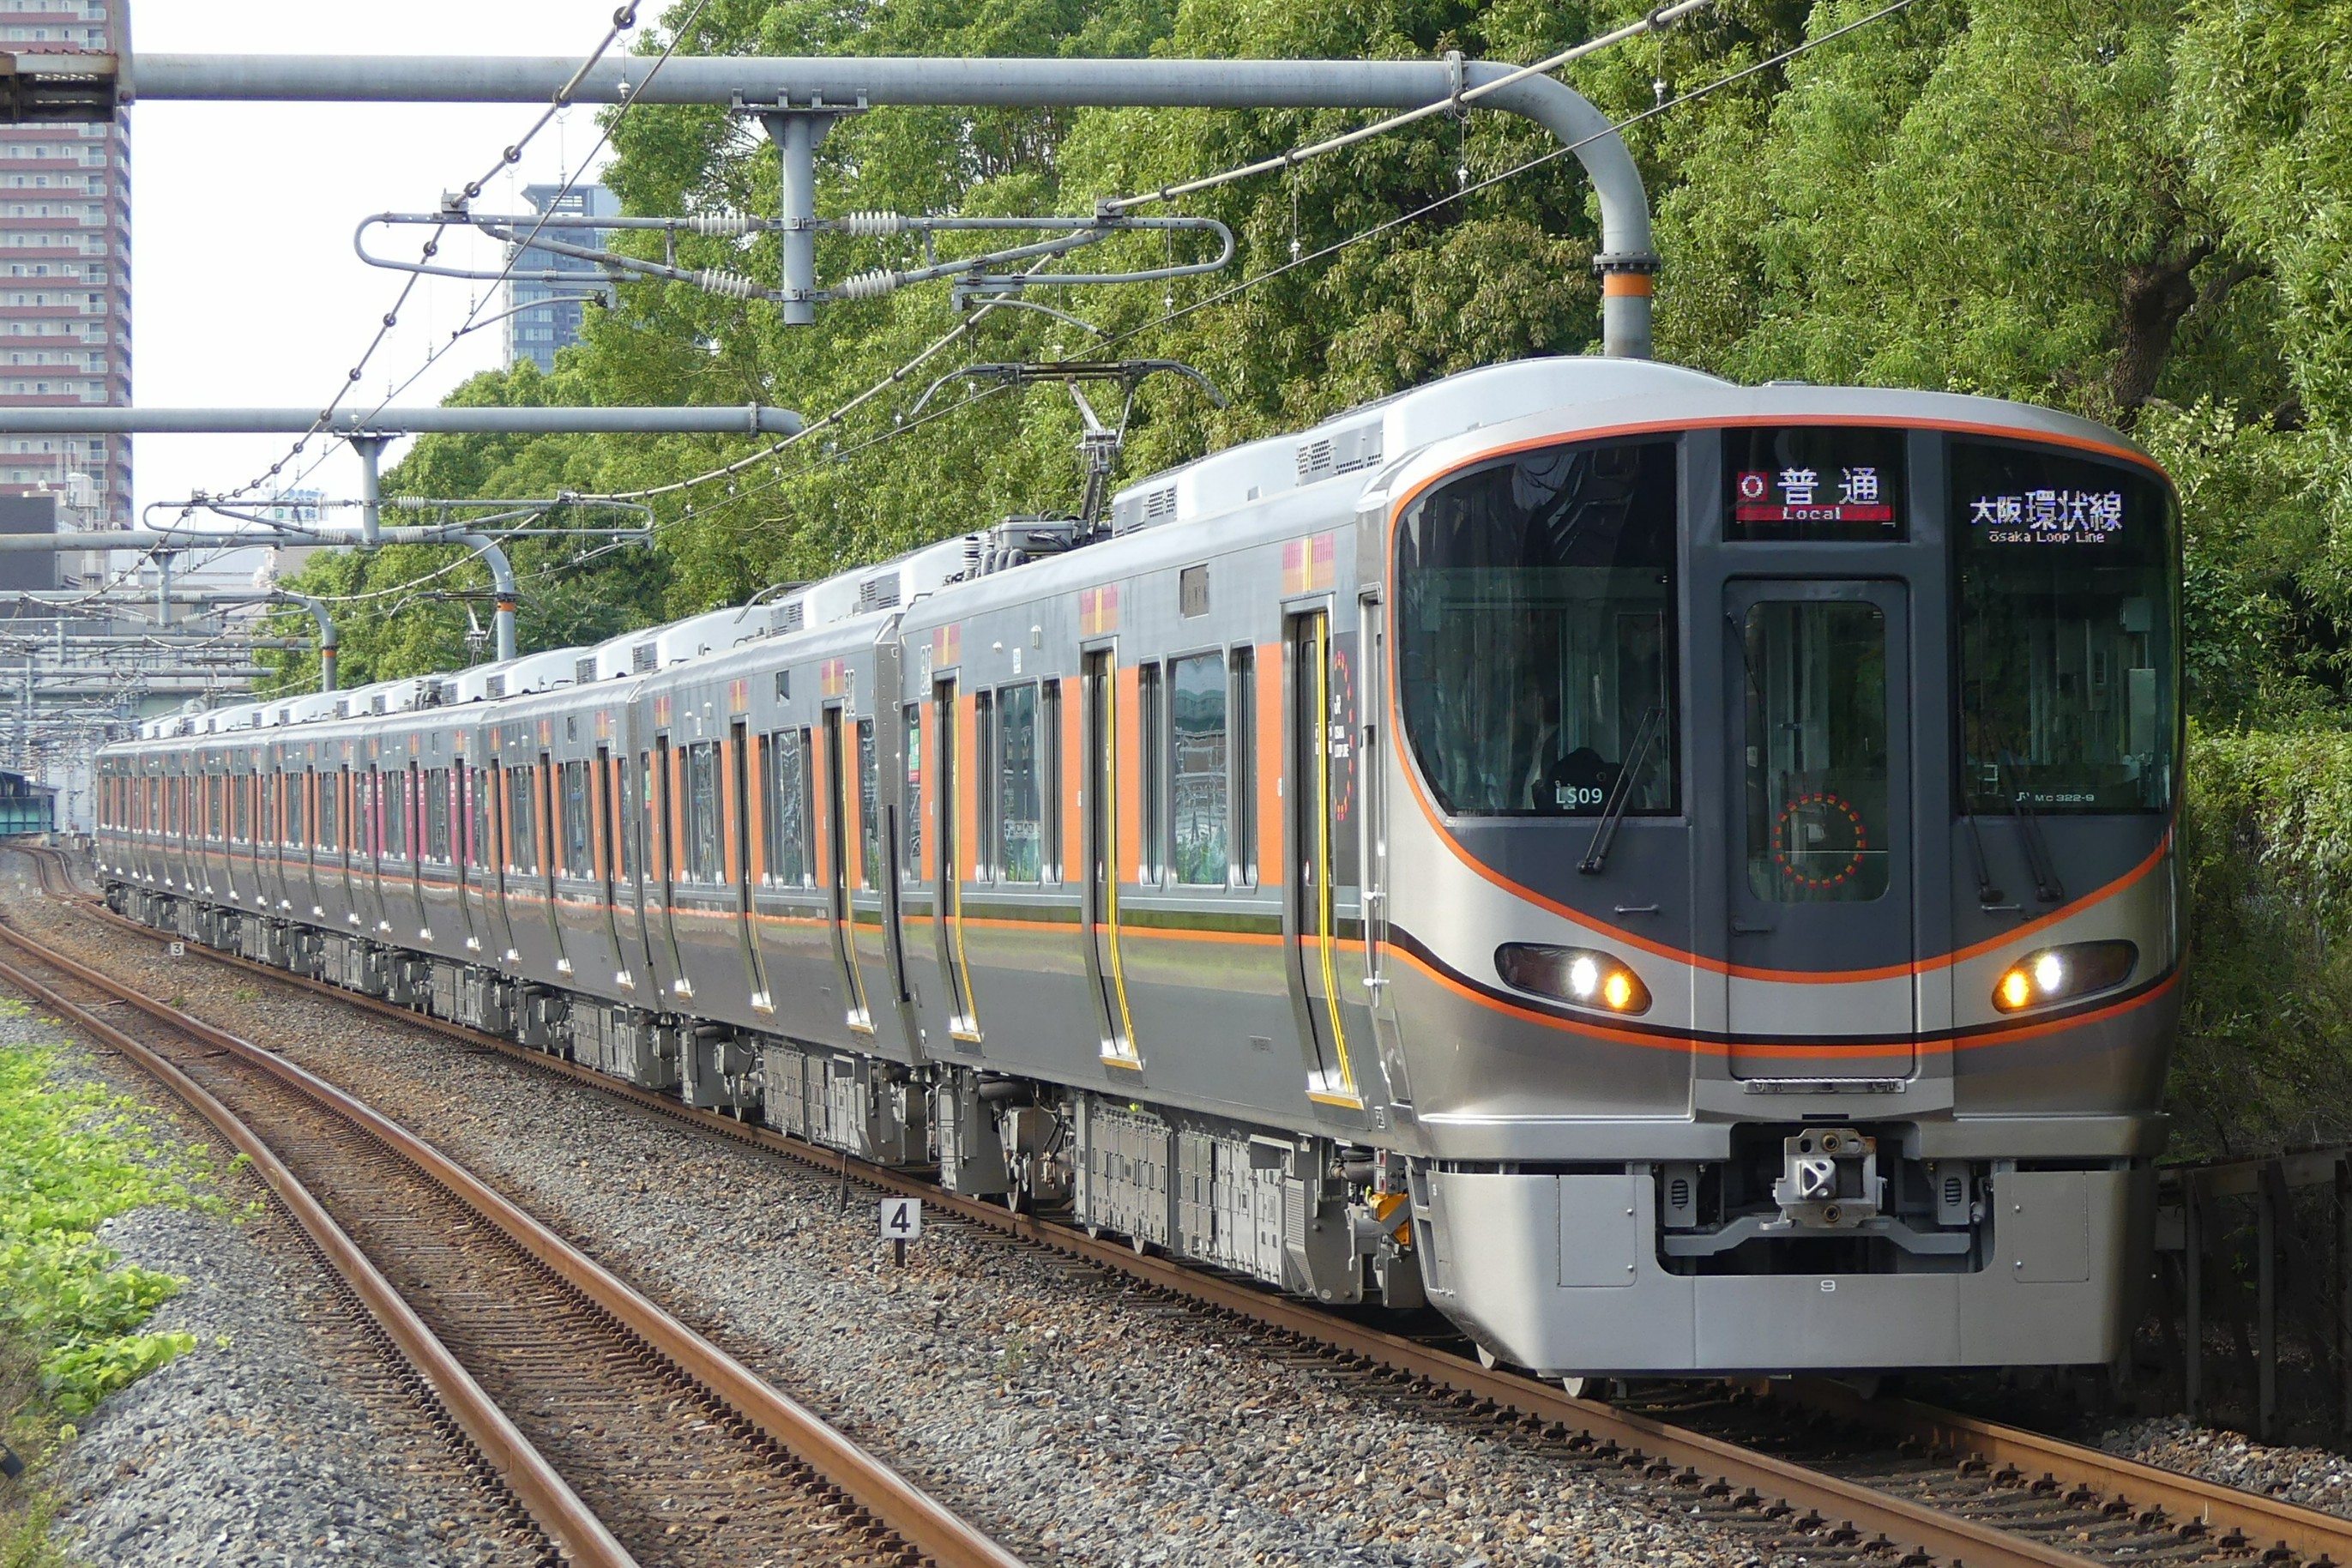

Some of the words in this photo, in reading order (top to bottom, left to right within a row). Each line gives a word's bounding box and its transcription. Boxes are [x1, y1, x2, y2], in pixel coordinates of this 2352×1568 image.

[1777, 467, 1879, 504] 普通
[1782, 507, 1842, 521] Local
[1969, 490, 2123, 531] 大阪環状線
[2036, 531, 2070, 544] Loop
[2076, 531, 2105, 543] Line
[1556, 787, 1603, 804] LS09
[173, 944, 181, 955] 3
[890, 1202, 911, 1233] 4
[1820, 1280, 1836, 1292] 9
